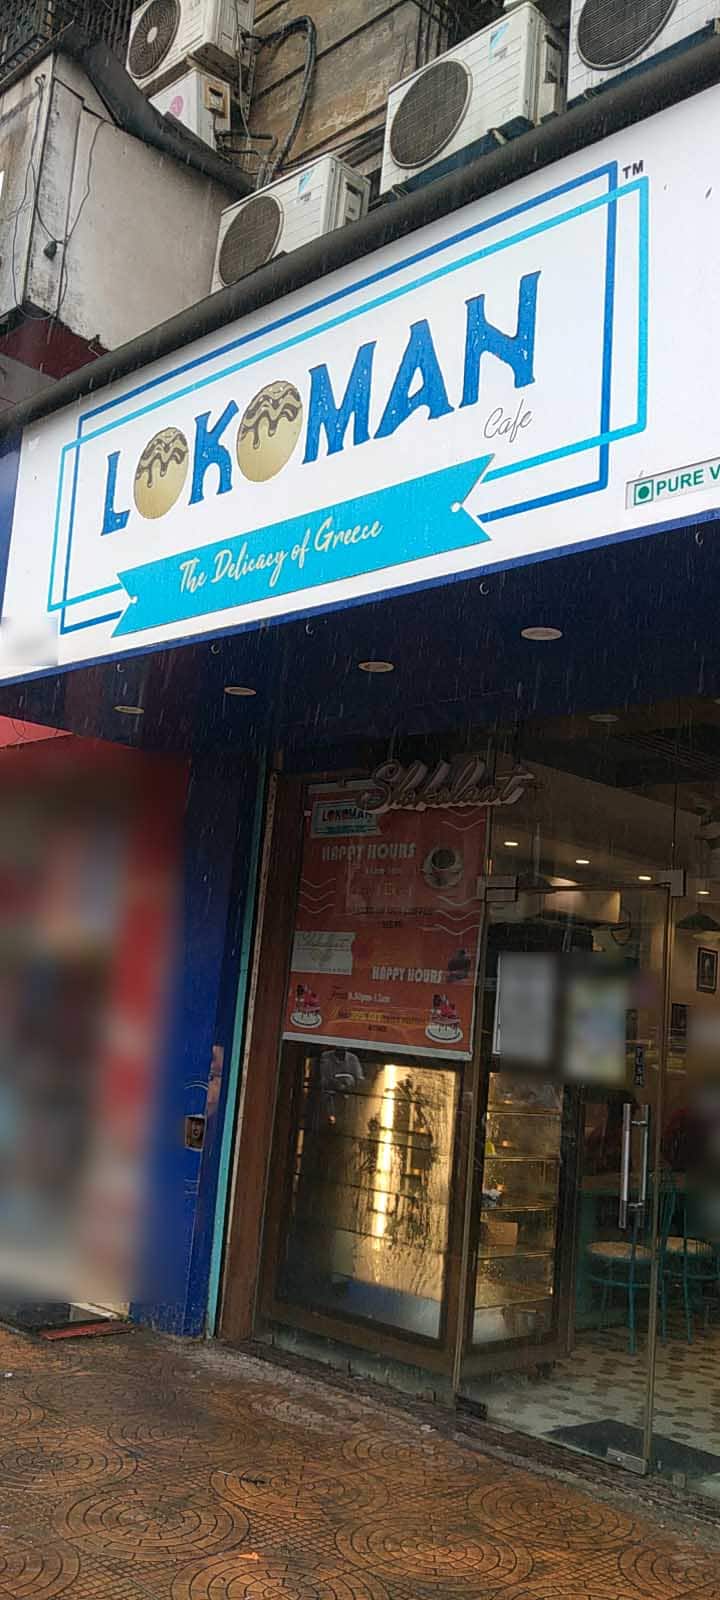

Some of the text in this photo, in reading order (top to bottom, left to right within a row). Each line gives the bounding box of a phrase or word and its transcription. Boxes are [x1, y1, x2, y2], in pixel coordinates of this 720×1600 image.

[622, 160, 644, 179] TM
[101, 270, 541, 536] LOKOMAN
[483, 398, 533, 443] Cafe
[656, 469, 705, 496] PURE
[179, 516, 384, 593] The Delicacy of Greece
[321, 842, 417, 863] HAPPY HOURS
[371, 965, 443, 984] HAPPY HOURS
